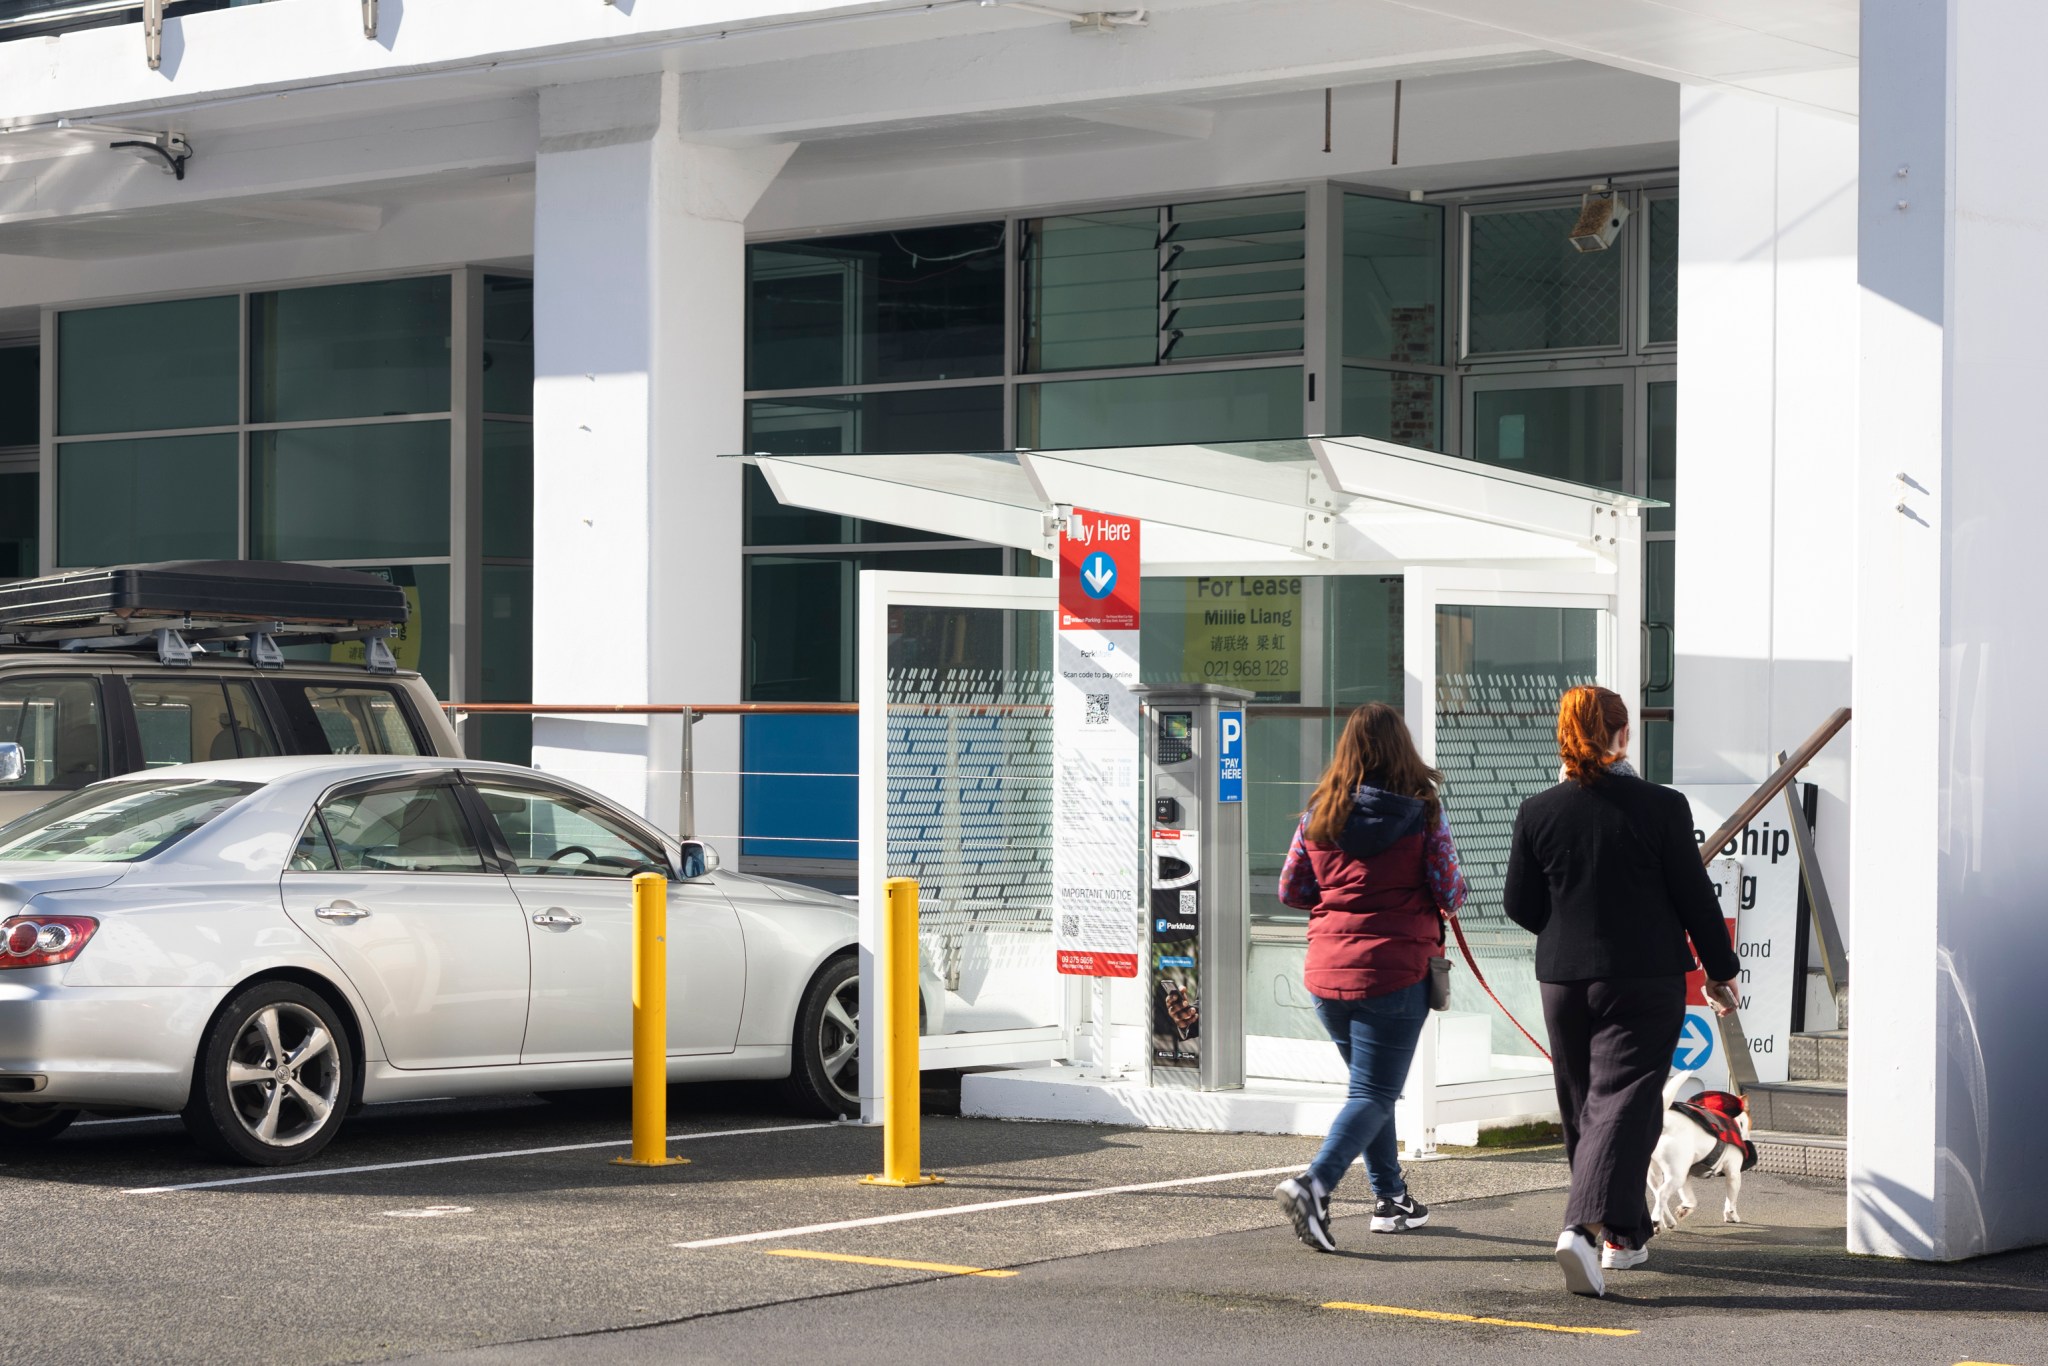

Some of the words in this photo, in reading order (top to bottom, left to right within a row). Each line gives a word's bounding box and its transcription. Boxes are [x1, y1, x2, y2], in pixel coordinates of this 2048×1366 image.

[1097, 519, 1131, 541] Here
[1197, 577, 1233, 598] For
[1240, 576, 1301, 597] Lease
[1204, 610, 1246, 626] Millie
[1250, 608, 1292, 627] Liang
[1210, 635, 1249, 652] 请联络
[1063, 671, 1078, 679] Scan
[1078, 671, 1094, 679] code
[1203, 660, 1229, 677] 021
[1232, 660, 1262, 677] 968
[1265, 659, 1289, 676] 128
[1222, 718, 1241, 754] P
[1225, 758, 1239, 769] PAY
[1221, 768, 1242, 779] HERE
[1061, 888, 1103, 899] IMPORTANT
[1105, 889, 1132, 900] NOTICE
[1167, 922, 1195, 930] ParkMate
[1061, 955, 1069, 964] 09
